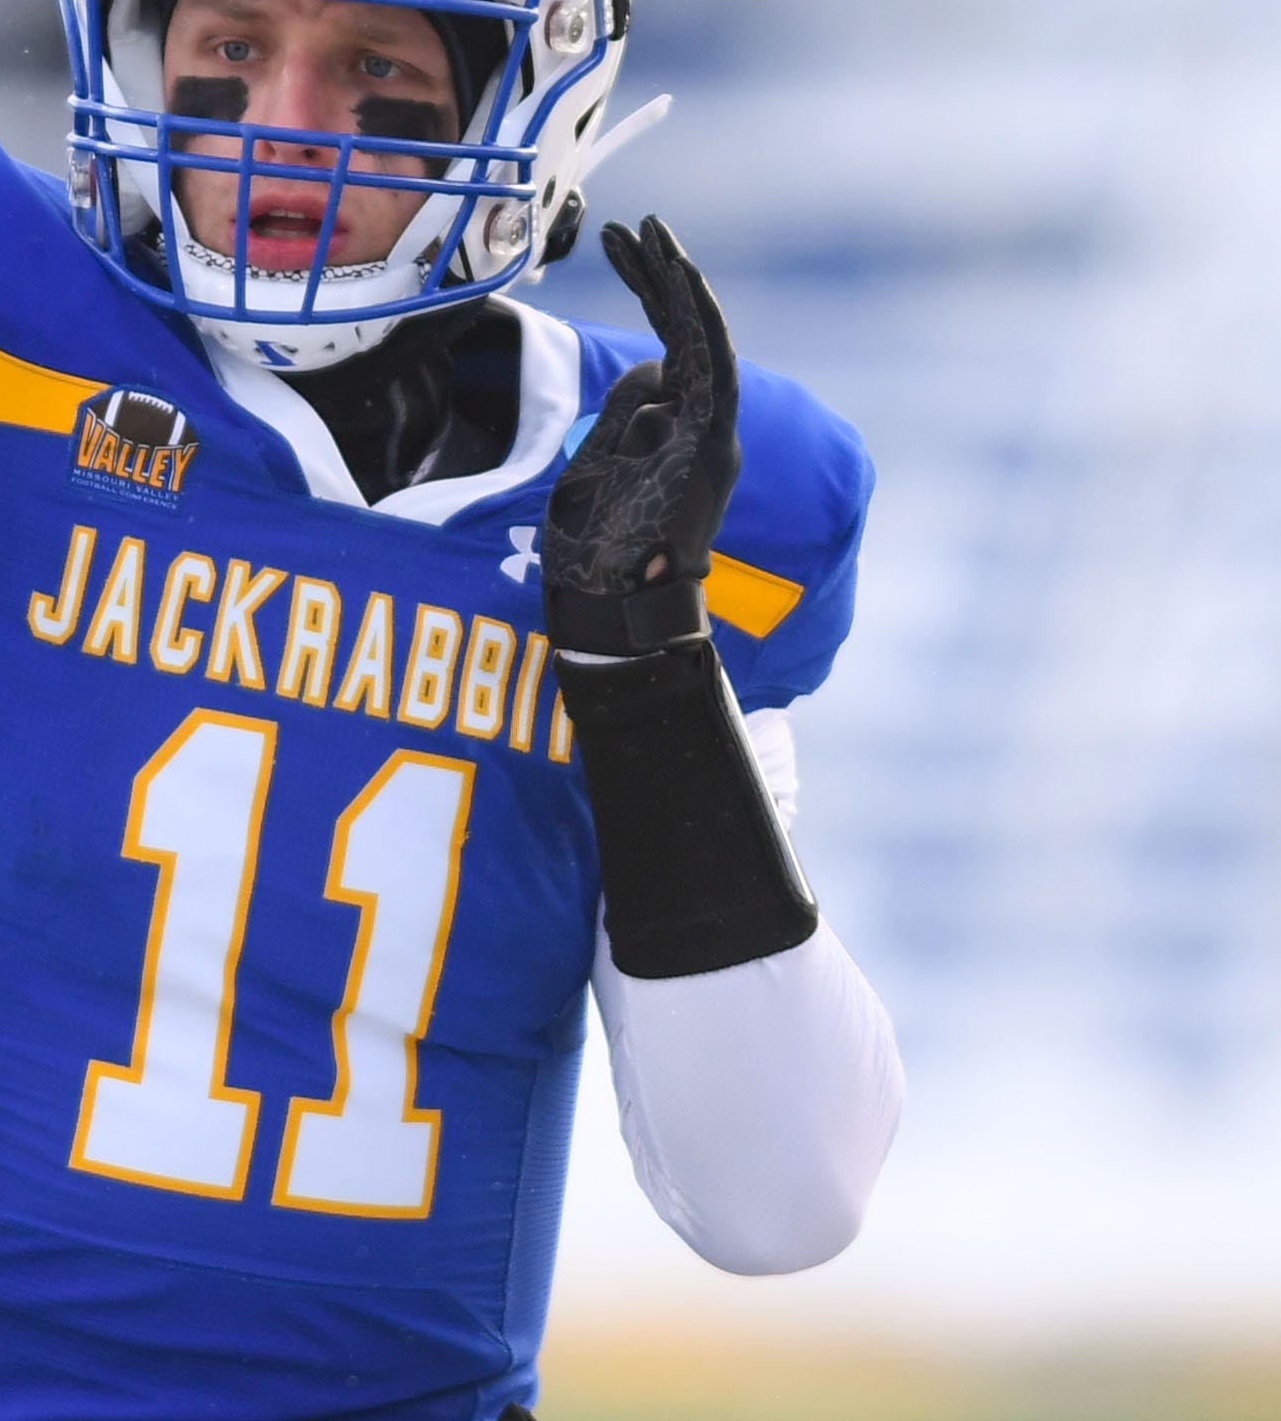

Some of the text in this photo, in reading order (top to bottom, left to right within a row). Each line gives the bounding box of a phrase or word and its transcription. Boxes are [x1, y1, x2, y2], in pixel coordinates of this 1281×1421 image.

[76, 407, 199, 493] VALLEY
[71, 477, 177, 510] FOOTBALL CONFERENCE
[73, 468, 179, 501] MISSOURI VALLEY
[68, 707, 477, 1219] 11
